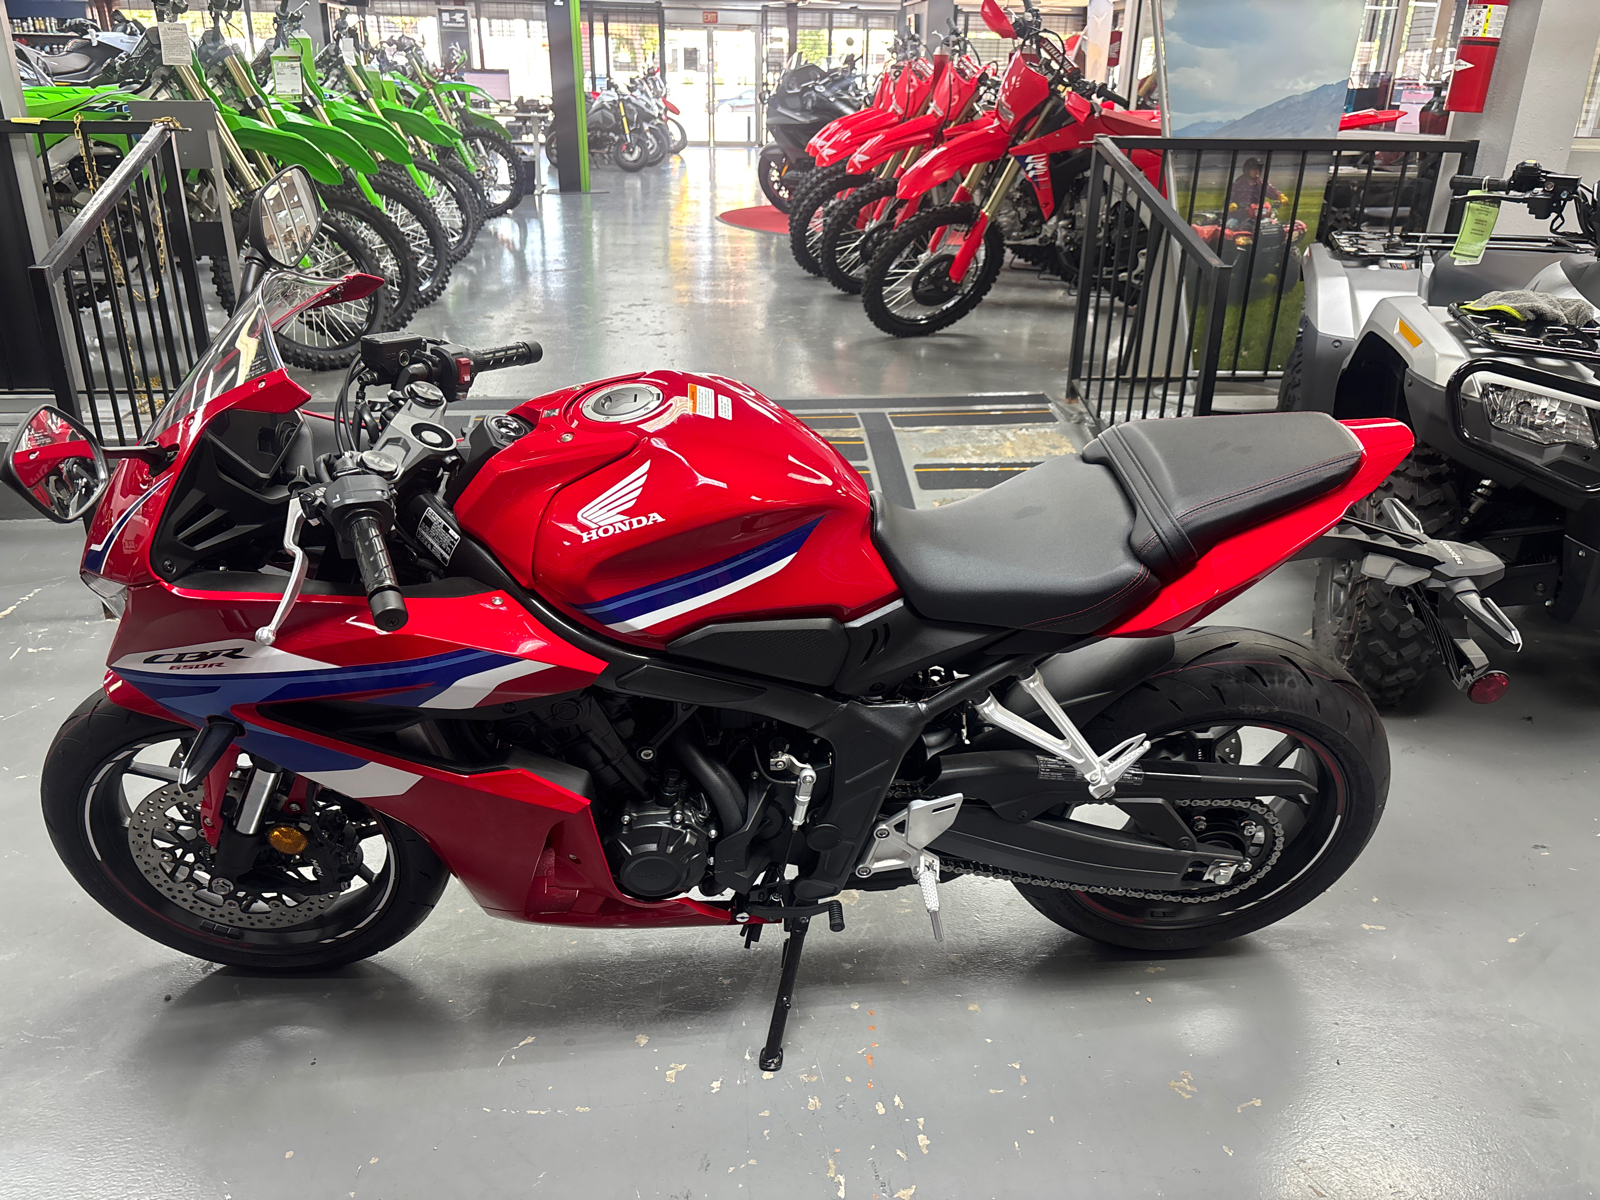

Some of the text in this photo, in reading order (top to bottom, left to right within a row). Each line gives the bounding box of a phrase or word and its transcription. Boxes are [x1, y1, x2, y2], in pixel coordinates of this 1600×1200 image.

[581, 512, 666, 544] HONDA
[142, 647, 252, 664] CBR
[168, 662, 227, 671] 650R
